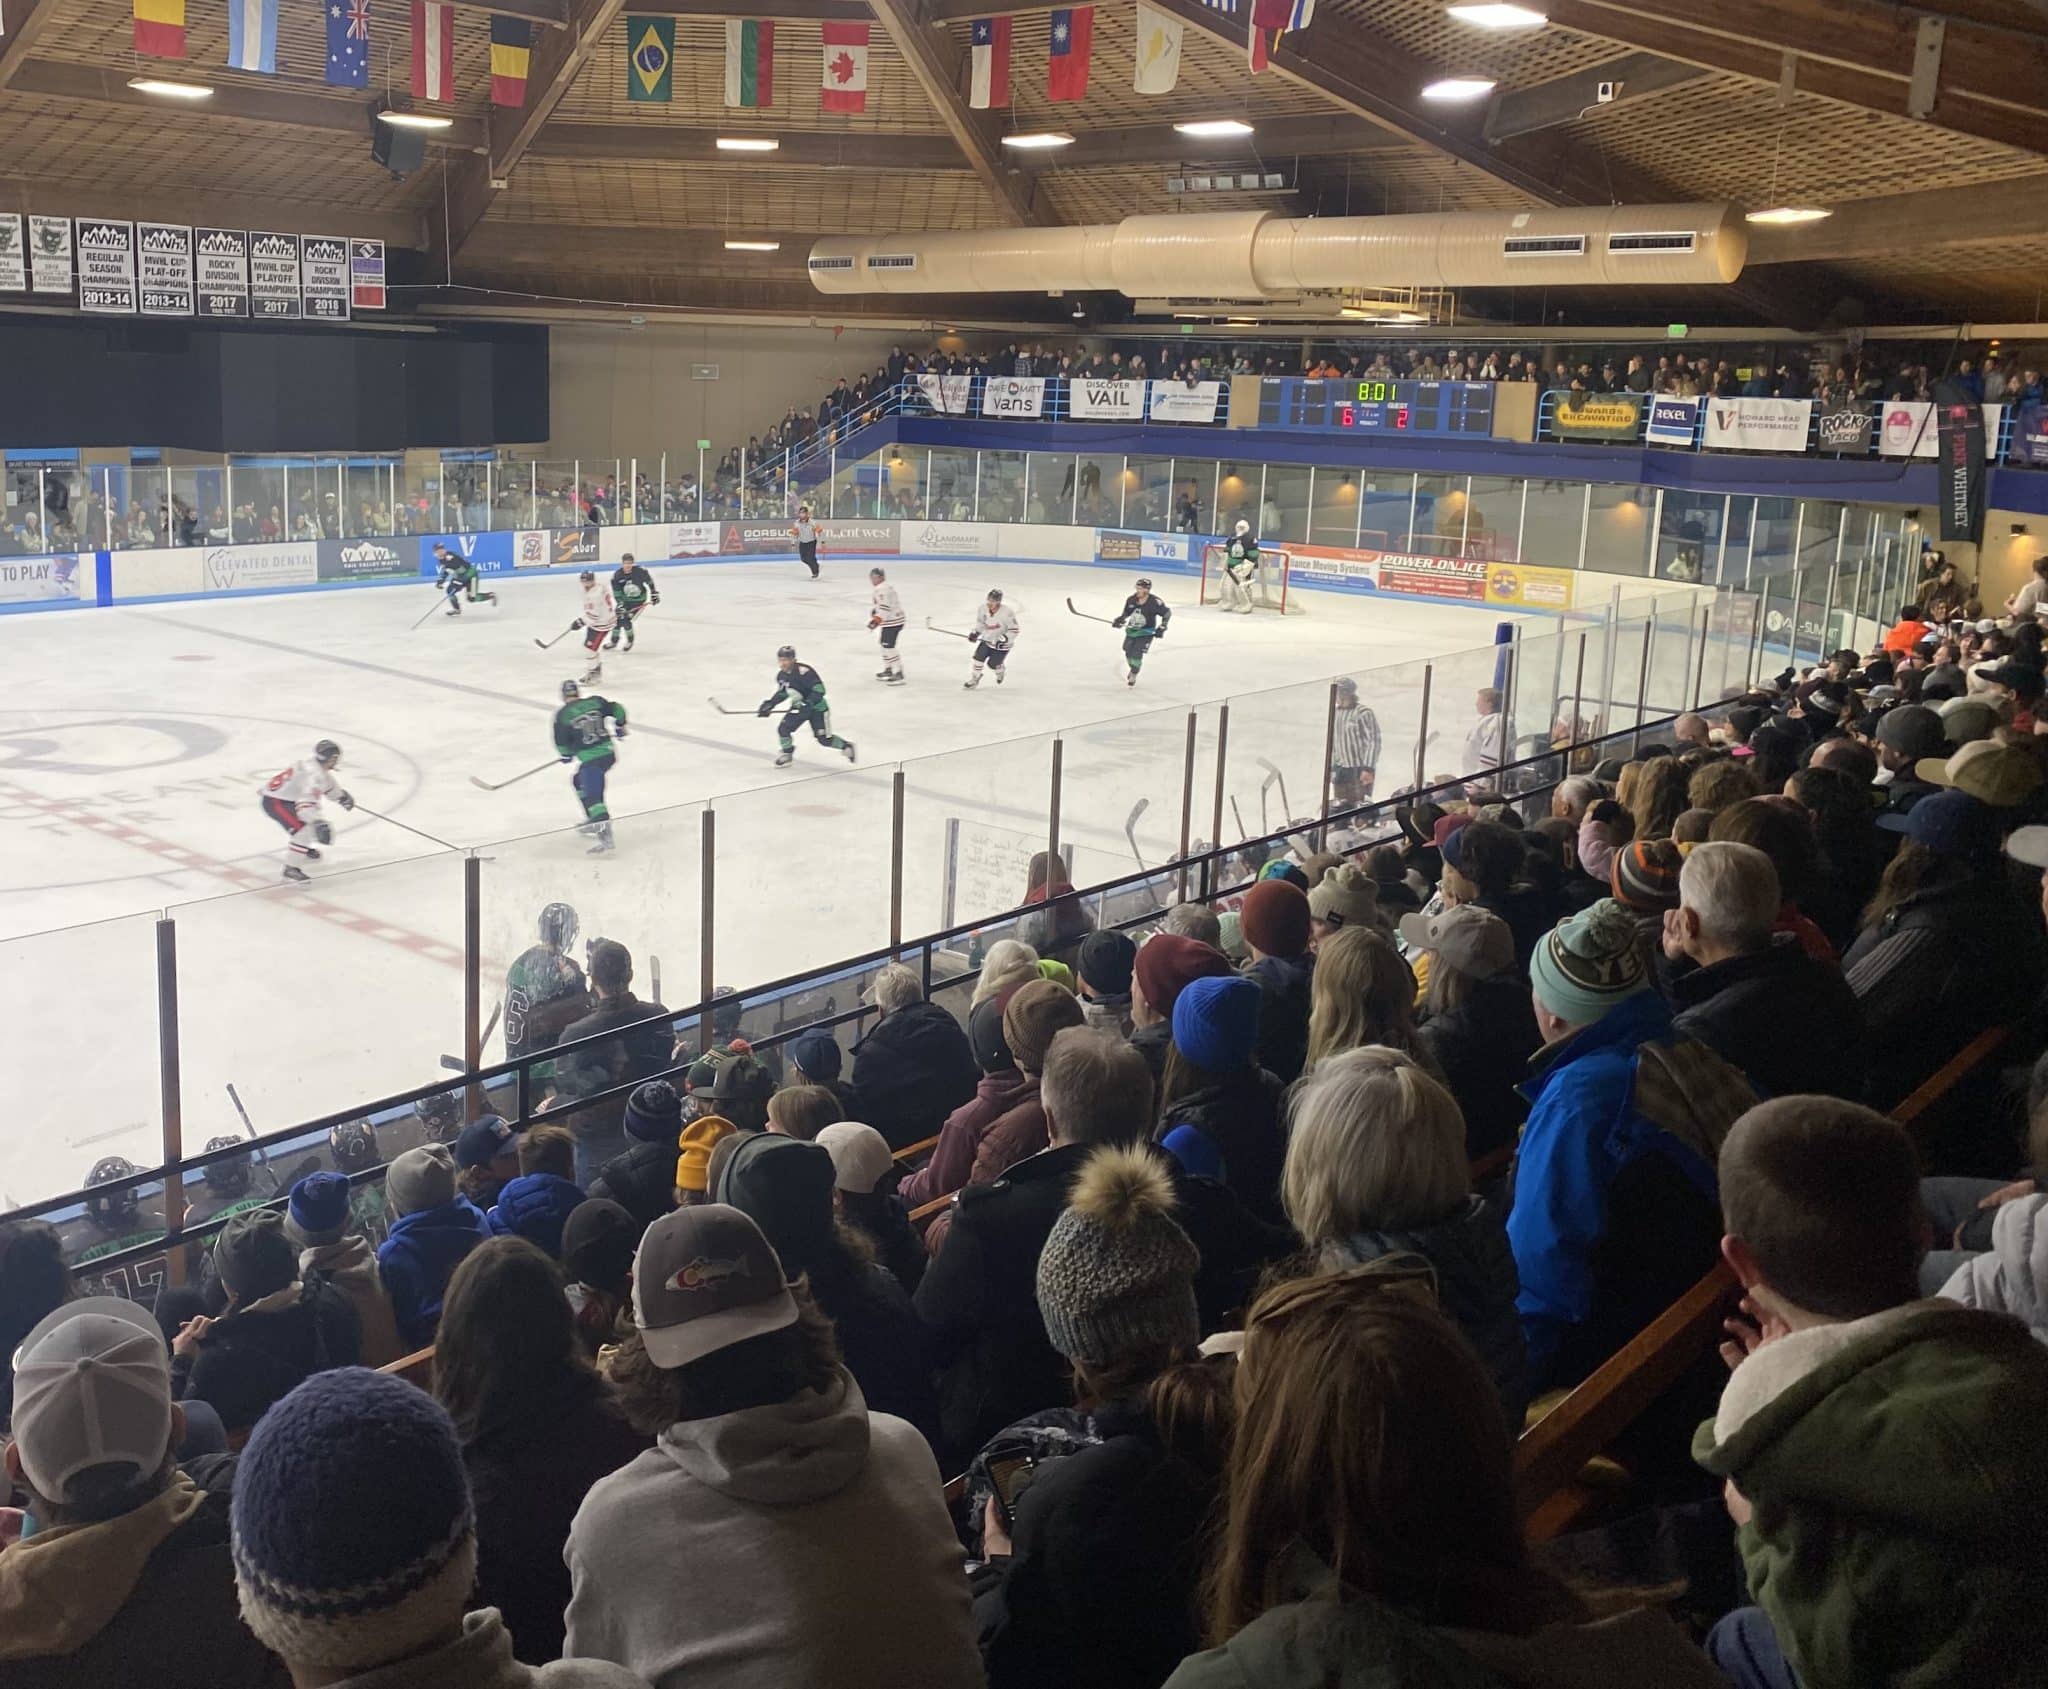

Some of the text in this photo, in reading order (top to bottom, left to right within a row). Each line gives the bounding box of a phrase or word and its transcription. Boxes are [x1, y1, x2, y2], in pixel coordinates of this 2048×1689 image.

[86, 252, 124, 263] REGULAR
[144, 256, 169, 266] MWHL
[89, 263, 122, 273] SEASON
[208, 260, 235, 270] ROCKY
[253, 262, 295, 273] MWHL CUP
[314, 266, 337, 275] ROCKY
[82, 275, 130, 285] CHAMPIONS
[205, 271, 240, 281] DIVISION
[256, 273, 294, 283] PLAYOFF
[311, 276, 341, 285] DIVISION
[199, 282, 246, 292] CHAMPIONS
[253, 284, 298, 294] CHAMPIONS
[305, 286, 346, 296] CHAMPIONS
[84, 291, 130, 305] 2013-14
[144, 294, 188, 307] 2013-14
[209, 296, 237, 308] 2017
[263, 301, 289, 313] 2017
[314, 299, 339, 310] 2018
[1020, 385, 1042, 393] MATT
[1086, 381, 1130, 390] DISCOVER
[1358, 382, 1397, 401] 8:01
[1087, 390, 1130, 406] VAIL
[1342, 408, 1353, 426] 6
[1397, 409, 1408, 428] 2
[1737, 423, 1799, 431] PERFORMANCE
[1820, 414, 1873, 436] ROCKY
[1828, 432, 1860, 444] TACO
[1954, 467, 1968, 528] WHITNEY
[743, 529, 794, 538] GORSUC
[862, 526, 891, 539] west
[935, 535, 979, 544] LANDMARK
[558, 532, 597, 562] Sabor
[1154, 543, 1176, 558] TV8
[215, 555, 313, 571] ELEVATED DENTAL
[471, 561, 501, 572] ALTH
[1312, 560, 1338, 573] Moving
[1340, 563, 1370, 576] Systems
[1382, 554, 1434, 569] POWER
[1437, 560, 1458, 571] ON
[1462, 562, 1488, 573] ICE
[2, 564, 50, 582] TO PLAY
